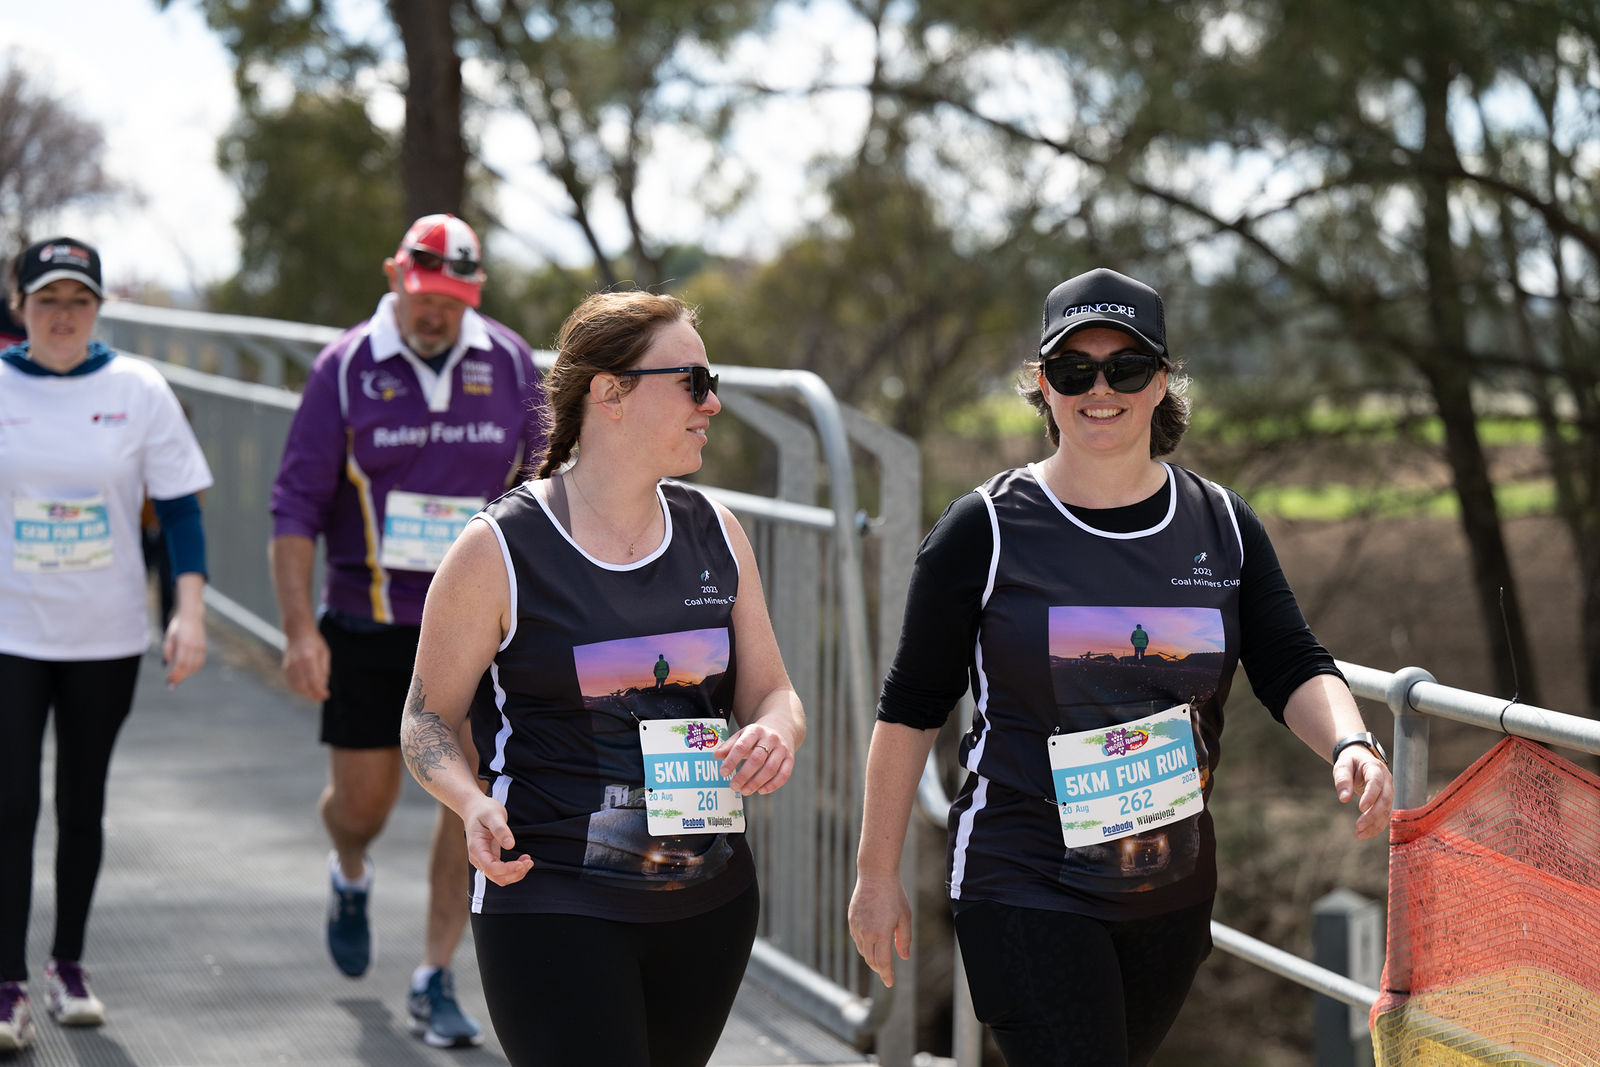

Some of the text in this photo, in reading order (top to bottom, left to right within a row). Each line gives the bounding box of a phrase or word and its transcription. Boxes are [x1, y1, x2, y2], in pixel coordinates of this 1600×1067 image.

[1065, 303, 1135, 318] GLENCORE
[373, 422, 505, 448] Relay For Life
[1193, 568, 1212, 576] 2023
[1171, 578, 1241, 587] Coal Miners Cup
[684, 598, 703, 606] Coal
[704, 597, 728, 605] Miners
[654, 761, 690, 784] 5KM
[694, 760, 718, 782] FUN
[1065, 745, 1188, 797] 5KM FUN RUN
[1181, 772, 1197, 785] 2023
[648, 792, 673, 801] 20 Aug
[697, 790, 718, 811] 261
[1118, 788, 1154, 816] 262
[1062, 804, 1089, 815] 20 Aug
[682, 818, 705, 829] Peabody
[1102, 807, 1176, 837] Peabody Wilpinjong
